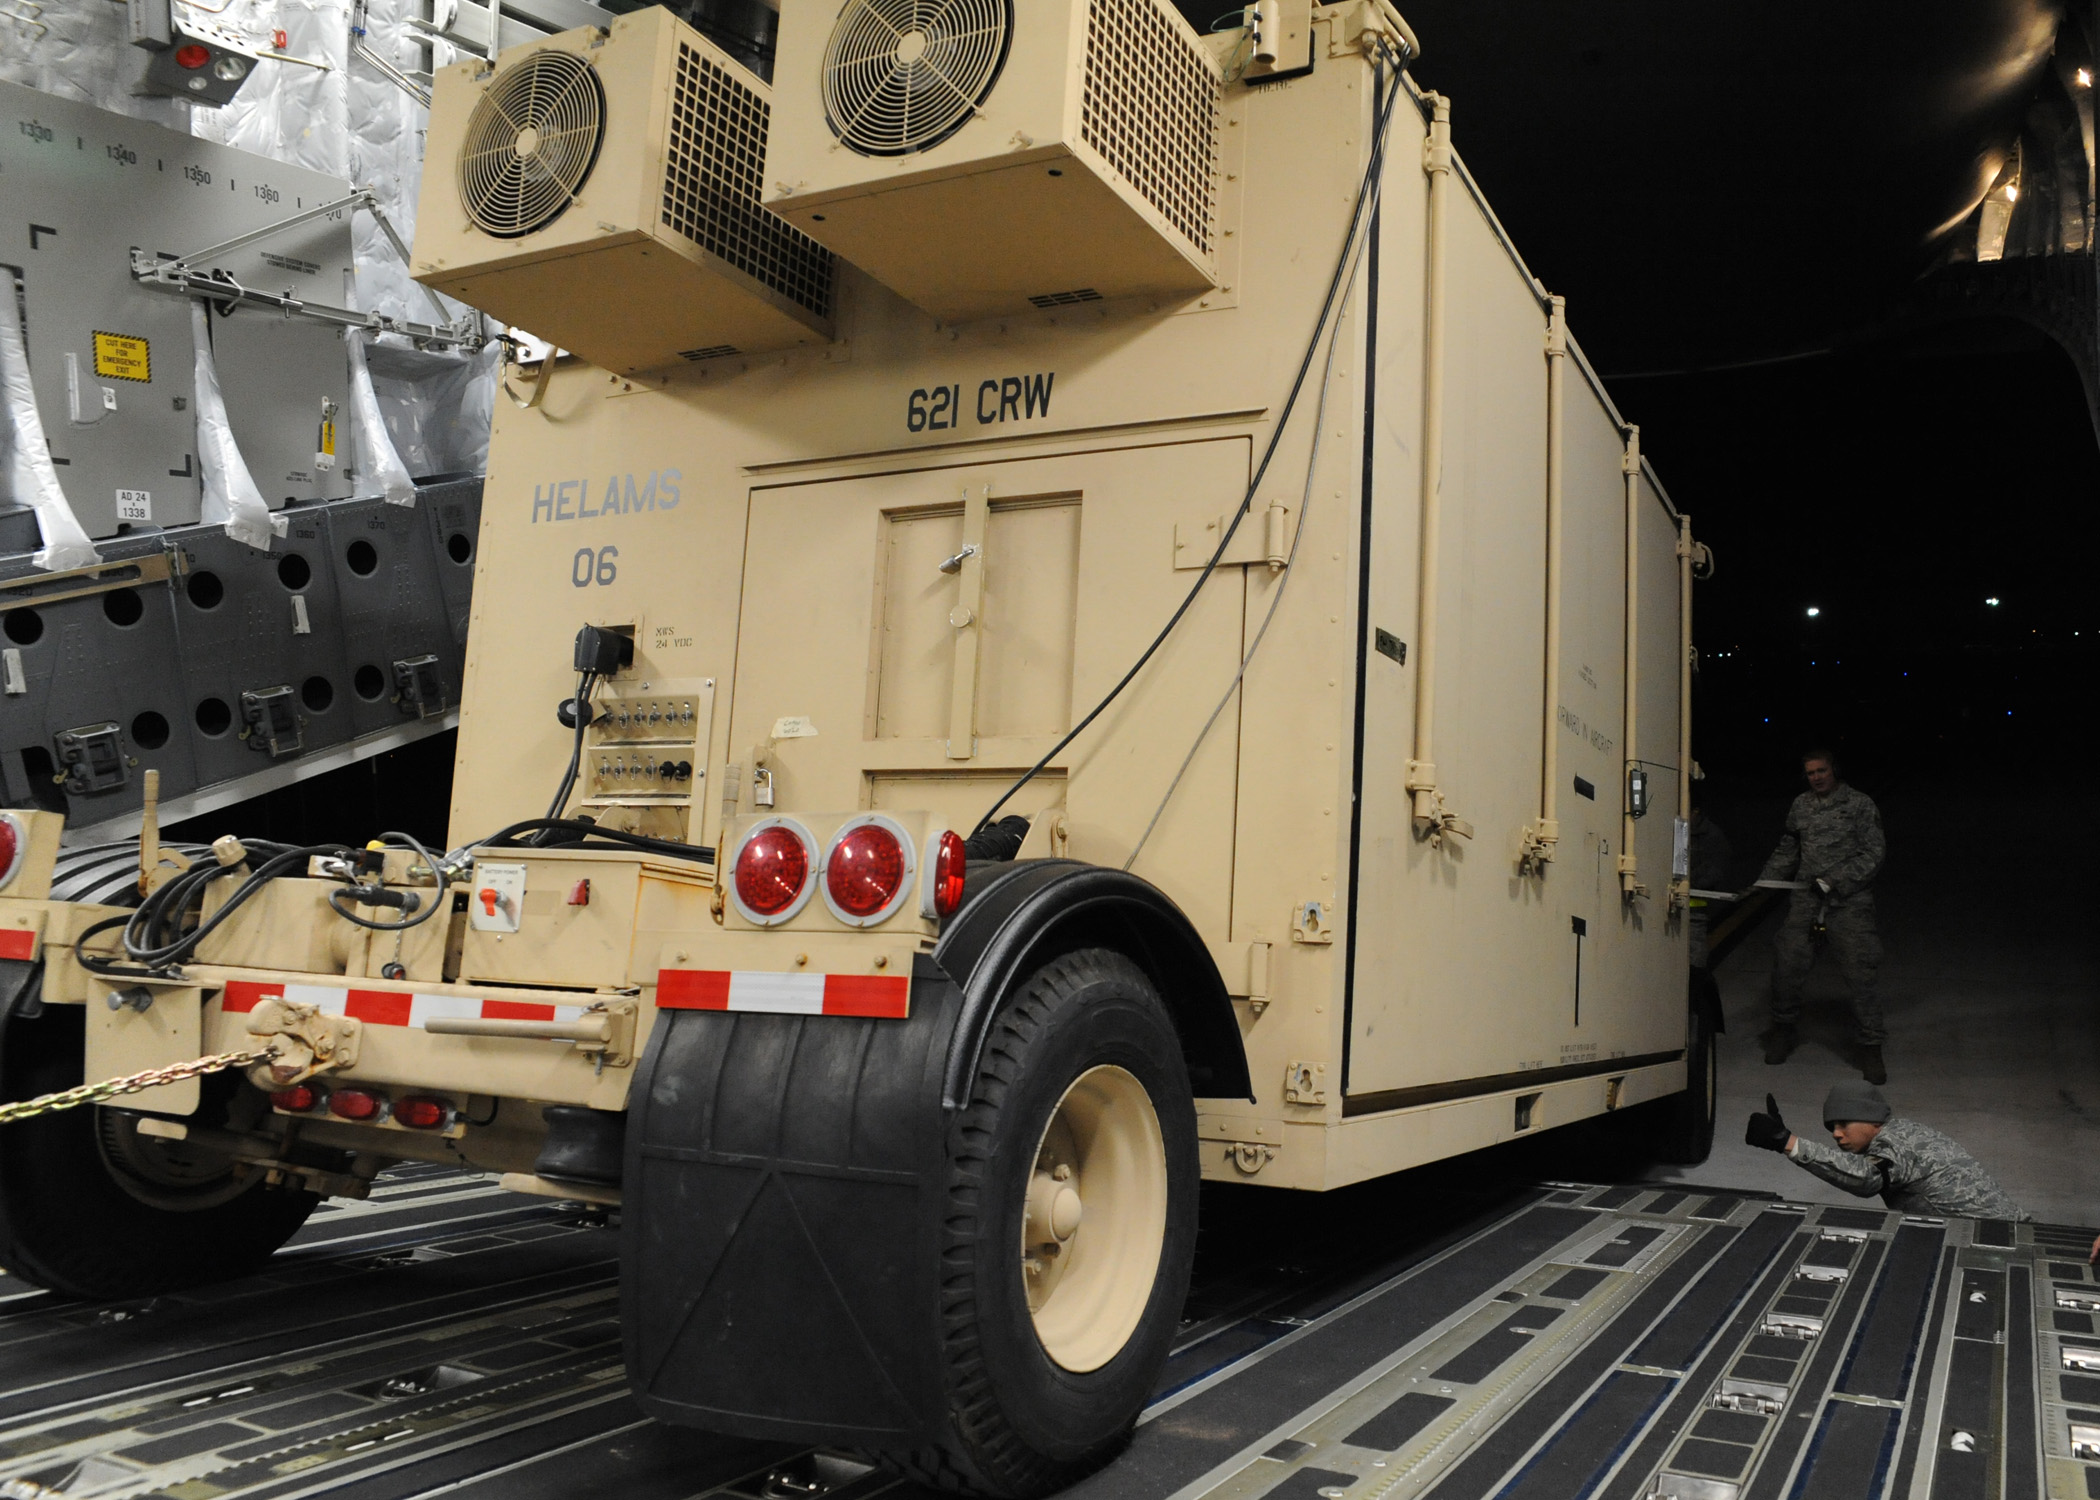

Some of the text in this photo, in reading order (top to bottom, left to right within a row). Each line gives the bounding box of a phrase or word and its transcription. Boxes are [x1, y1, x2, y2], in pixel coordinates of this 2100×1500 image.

[19, 121, 53, 142] 1330
[106, 145, 137, 165] 1340
[184, 166, 211, 185] 1350
[254, 185, 279, 203] 1360
[106, 339, 136, 350] CUT HERE
[116, 348, 128, 357] FOR
[103, 355, 141, 368] EMERGENCY
[116, 366, 129, 374] EXIT
[906, 372, 1054, 432] 621 CRW
[121, 491, 146, 502] AD 24
[531, 468, 683, 524] HELAMS
[123, 507, 145, 518] 1338
[572, 545, 618, 588] 06
[655, 637, 693, 649] 24 VDC
